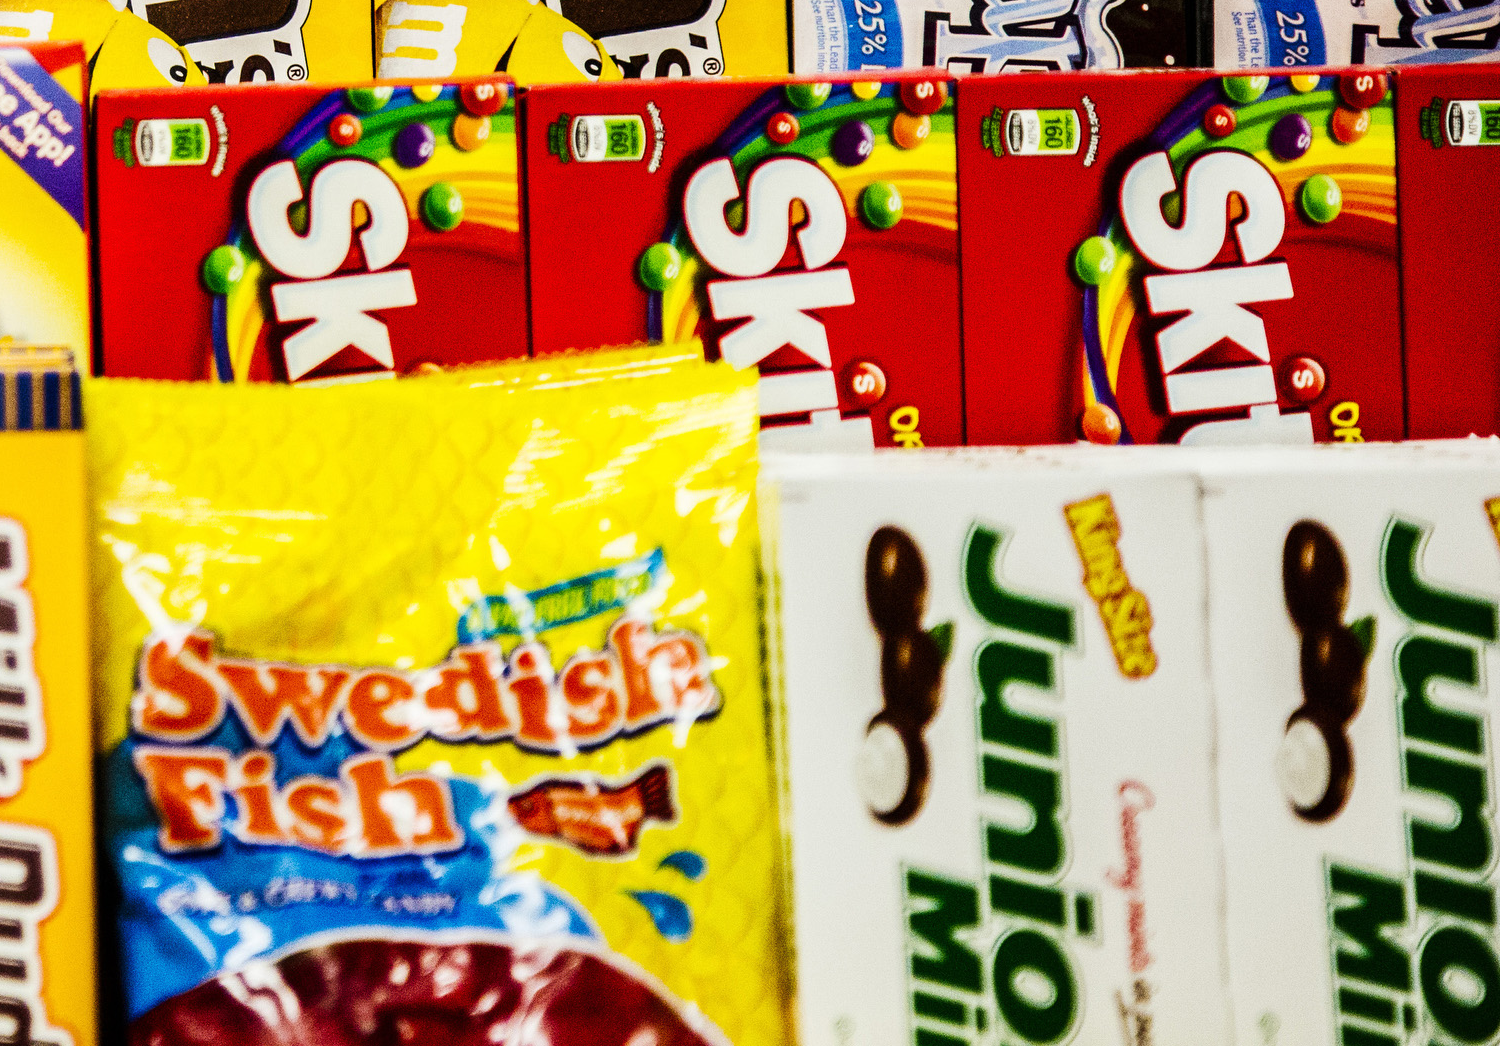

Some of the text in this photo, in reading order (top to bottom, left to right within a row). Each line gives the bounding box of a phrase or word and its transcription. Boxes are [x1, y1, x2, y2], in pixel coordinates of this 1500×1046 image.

[853, 0, 887, 55] 25%
[1276, 12, 1310, 66] 25%
[13, 111, 76, 167] App!
[609, 122, 629, 156] 160
[1043, 116, 1063, 150] 160
[247, 159, 418, 386] Sk
[136, 616, 718, 752] Swedish
[138, 751, 464, 854] Fish
